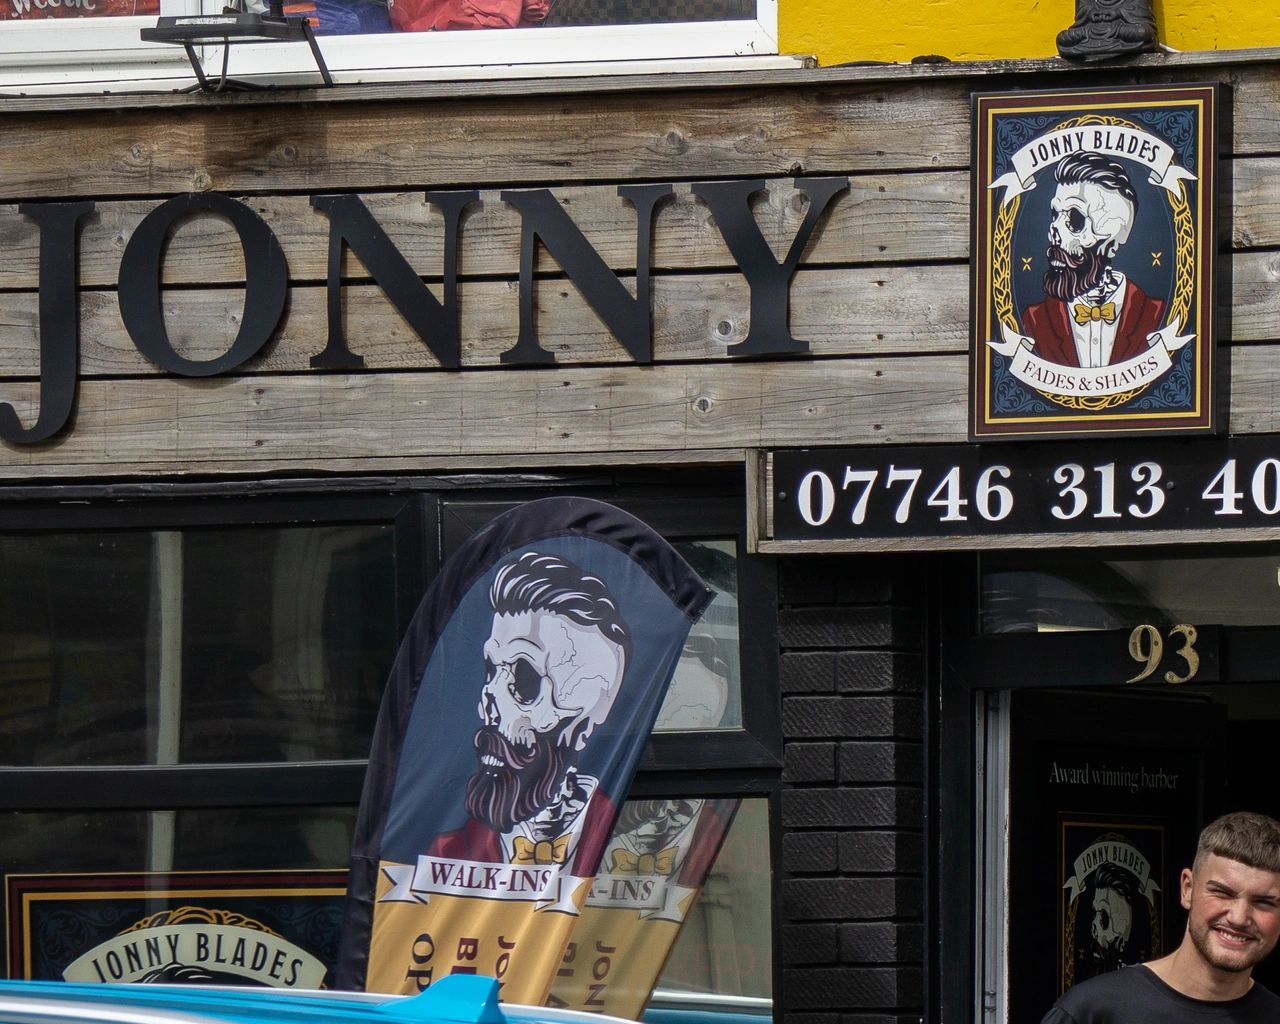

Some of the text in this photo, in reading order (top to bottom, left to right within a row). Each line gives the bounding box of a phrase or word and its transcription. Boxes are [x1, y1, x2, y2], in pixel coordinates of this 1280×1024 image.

[1029, 131, 1160, 168] JONNY BLADES
[2, 176, 850, 445] JONNY
[1022, 356, 1158, 391] FADES & SHAVES
[798, 464, 1014, 526] 07746
[1051, 462, 1165, 520] 313
[1125, 623, 1200, 684] 93
[1049, 761, 1179, 794] Award winning barber
[430, 861, 553, 893] WALK-INS
[1082, 845, 1144, 875] JONNY BLADES
[196, 933, 303, 986] BLADES
